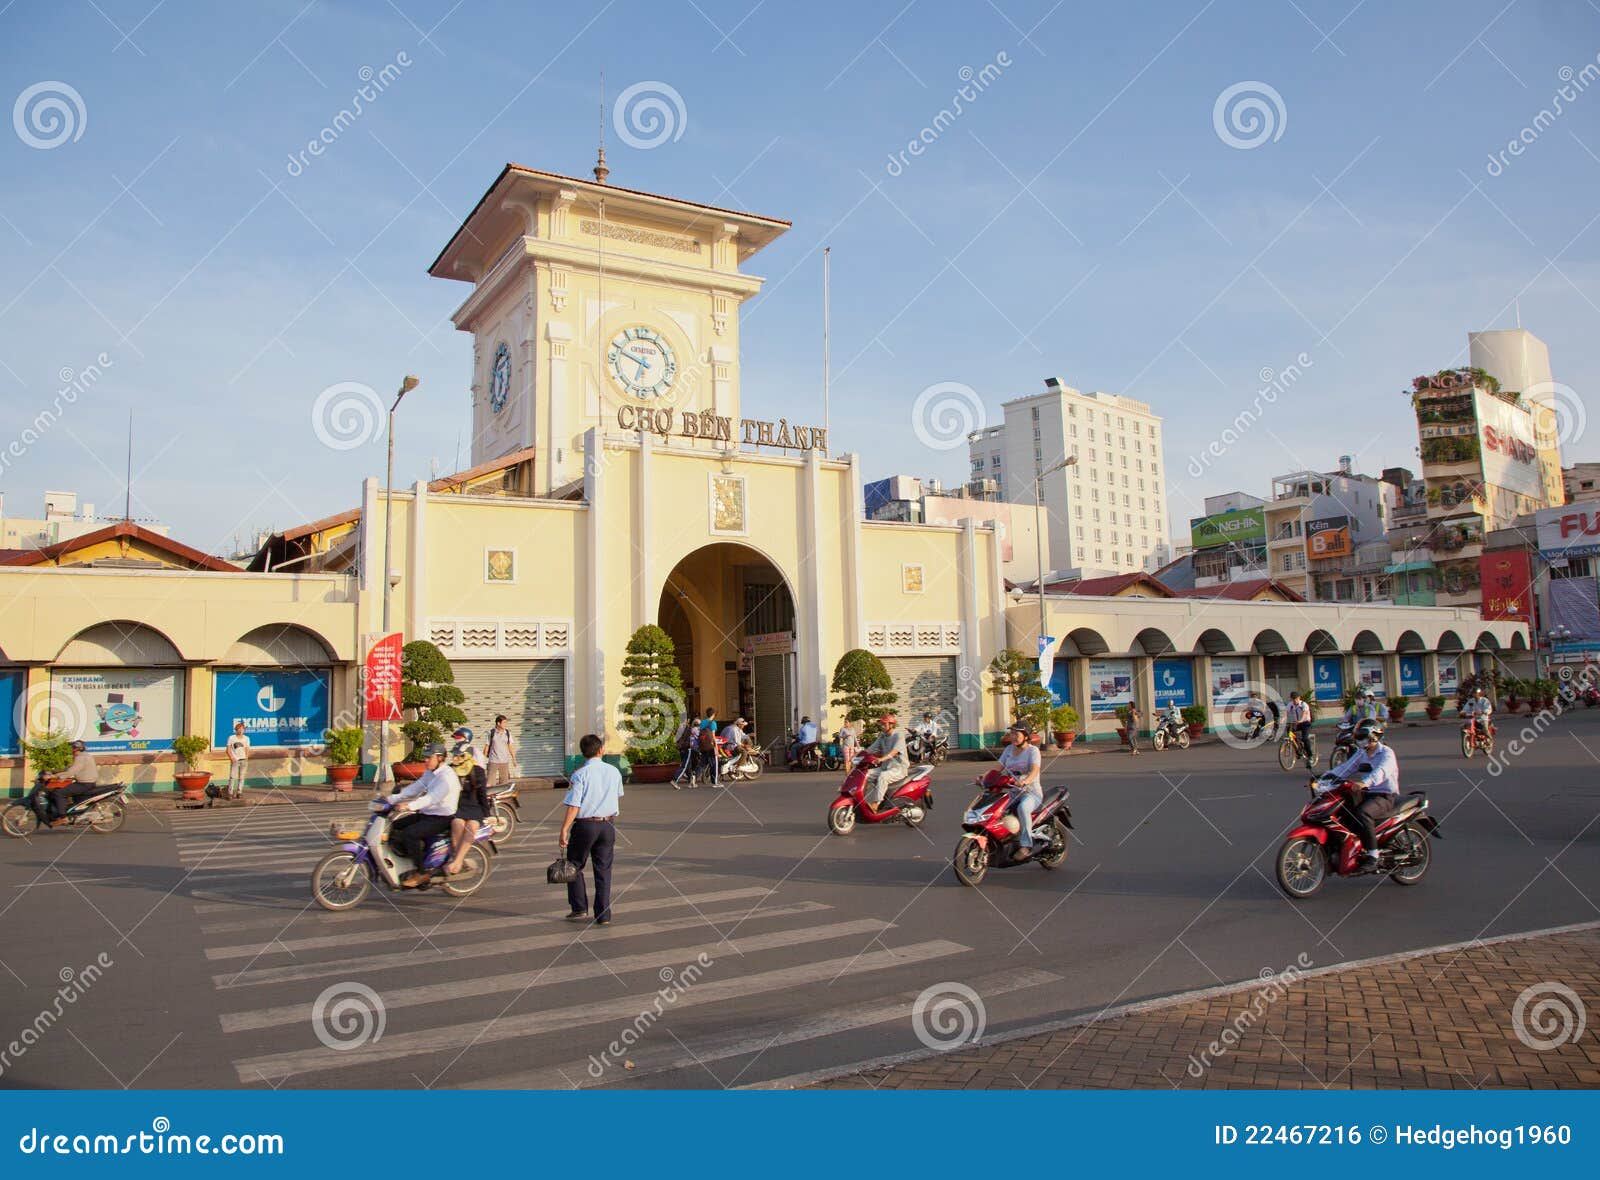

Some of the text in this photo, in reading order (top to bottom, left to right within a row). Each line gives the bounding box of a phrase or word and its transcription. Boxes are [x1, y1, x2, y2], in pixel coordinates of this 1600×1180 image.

[617, 405, 828, 451] CHỢ BẾN THÀNH
[1484, 425, 1536, 465] SHARP
[232, 717, 309, 729] EXIMBANK
